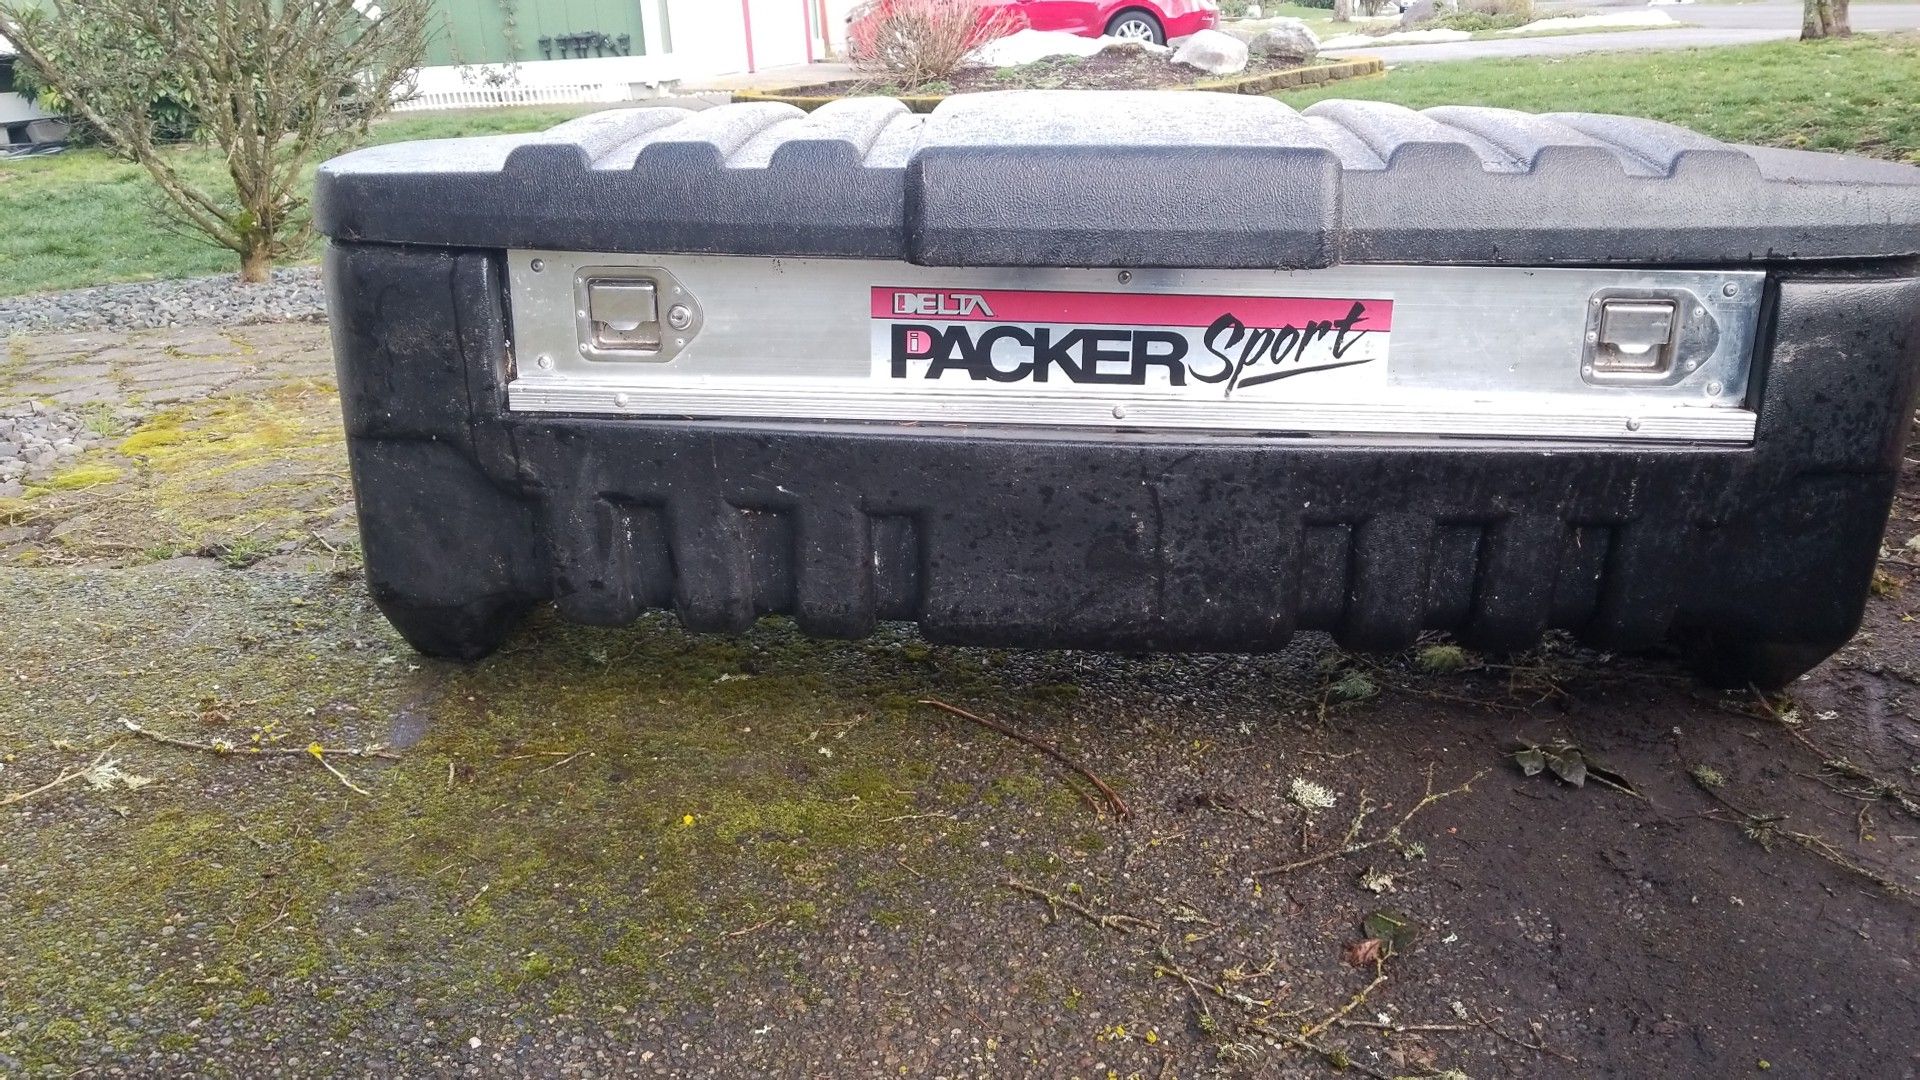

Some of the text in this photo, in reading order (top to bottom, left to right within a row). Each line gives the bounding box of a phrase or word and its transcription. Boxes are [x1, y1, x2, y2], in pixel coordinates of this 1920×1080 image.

[893, 292, 994, 317] DELTA
[891, 302, 1370, 398] PACKER Sport
